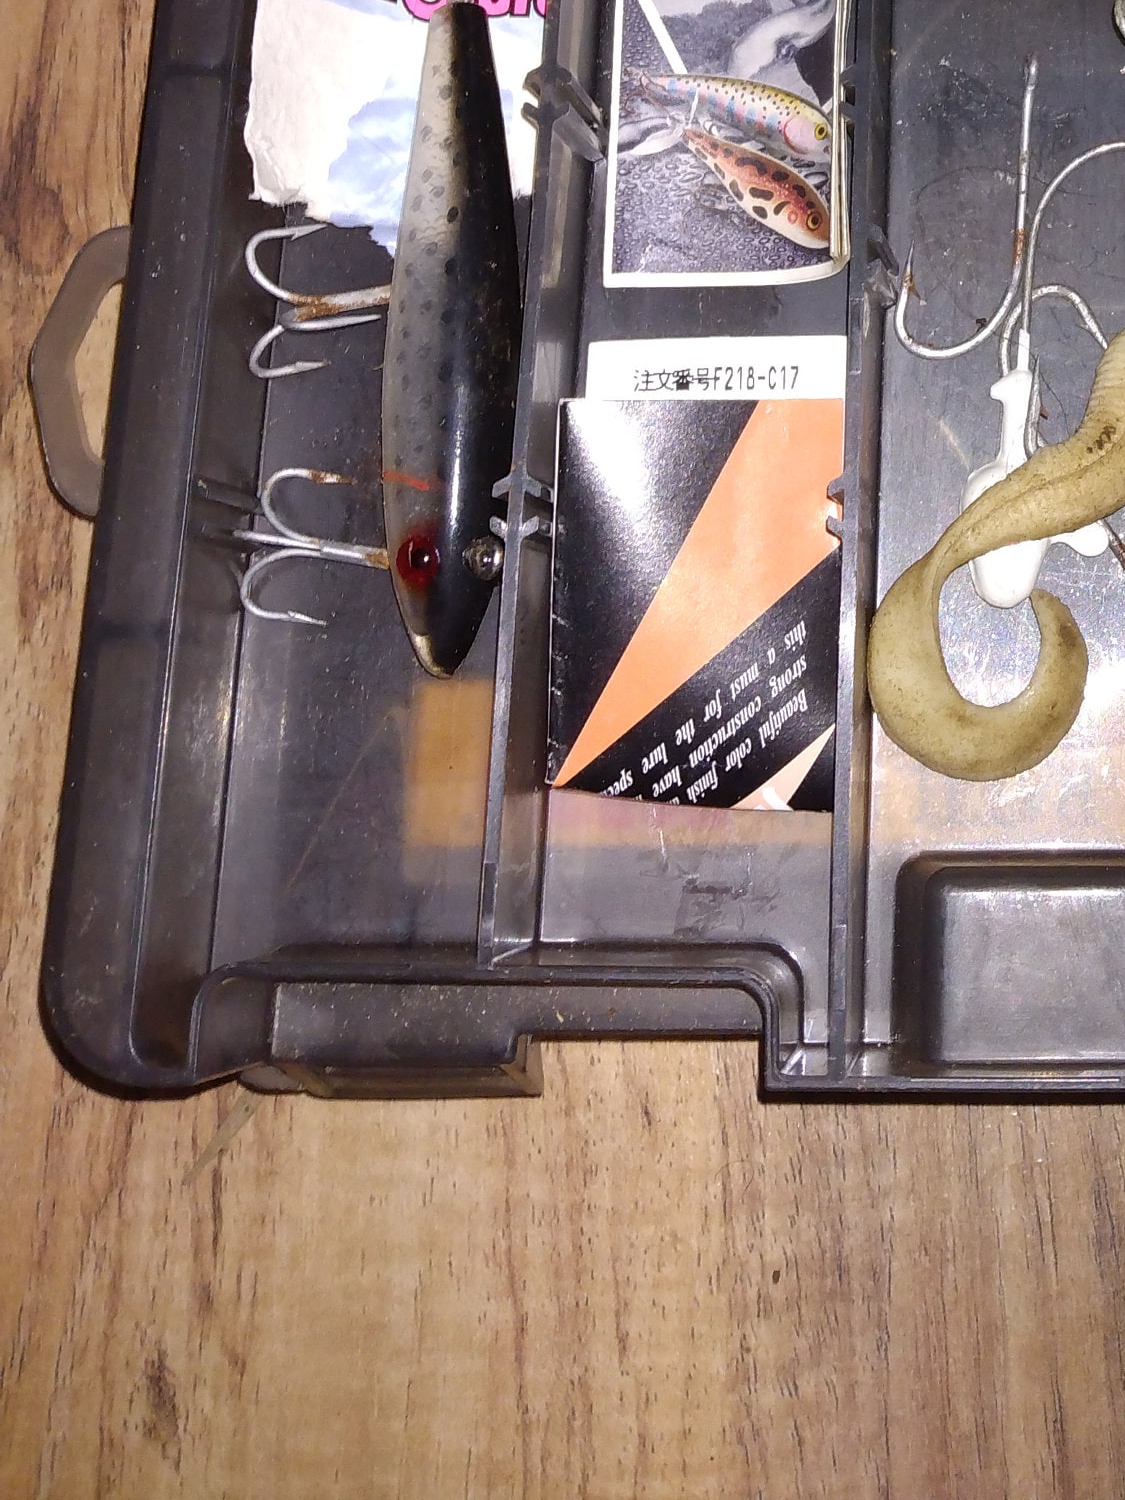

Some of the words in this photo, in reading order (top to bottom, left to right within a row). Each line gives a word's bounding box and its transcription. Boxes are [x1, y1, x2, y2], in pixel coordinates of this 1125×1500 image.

[784, 620, 807, 652] this
[767, 647, 776, 665] a
[729, 662, 760, 701] must
[769, 655, 807, 698] strong
[703, 689, 722, 722] for
[759, 688, 808, 749] Beautiful
[674, 718, 696, 746] the
[689, 695, 762, 769] construction
[641, 742, 668, 774] lure
[725, 737, 752, 773] color
[652, 765, 682, 798] have
[686, 760, 720, 804] finish
